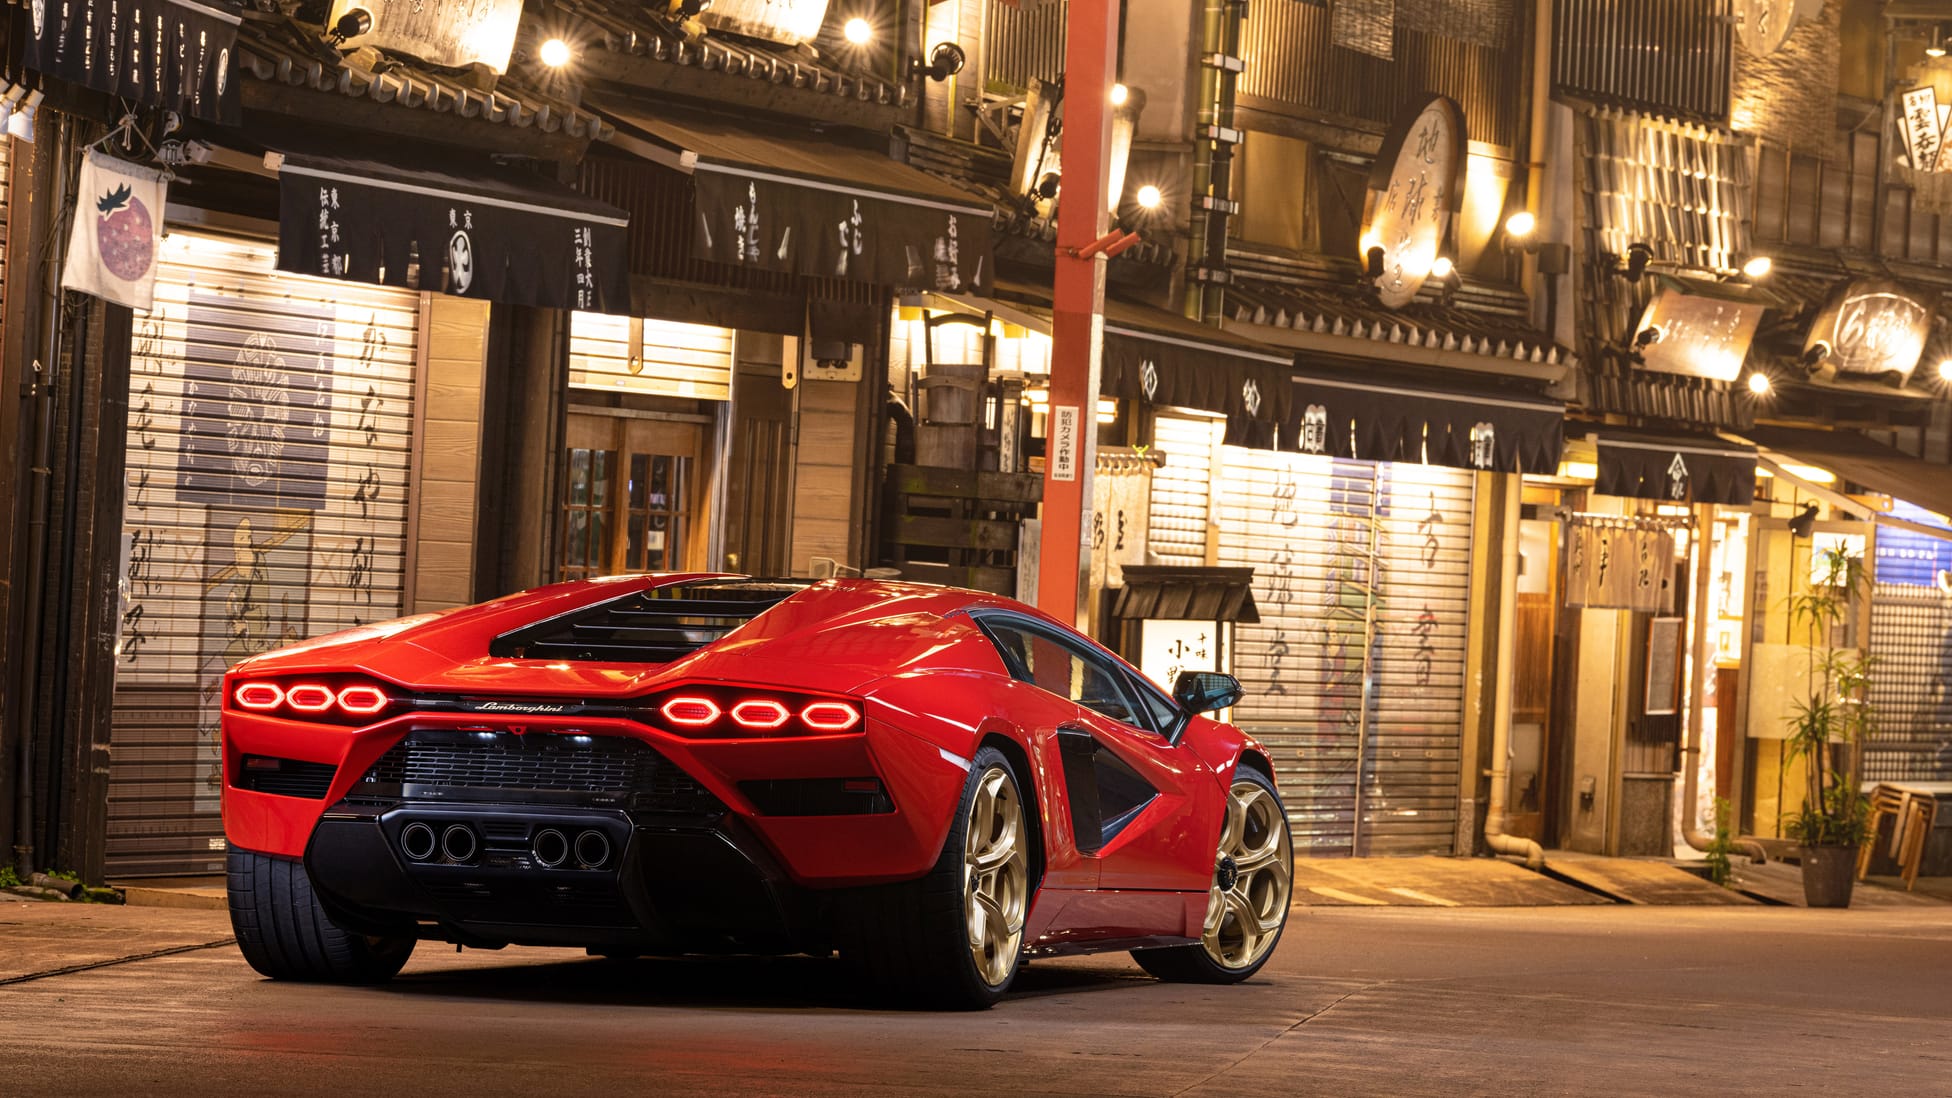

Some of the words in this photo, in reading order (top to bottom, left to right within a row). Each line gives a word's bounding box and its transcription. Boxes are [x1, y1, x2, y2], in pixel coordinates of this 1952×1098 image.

[331, 187, 342, 275] 東京都
[449, 208, 473, 230] 東京
[574, 228, 585, 309] 三年四月
[1058, 411, 1072, 470] 防犯カメラ作動中
[1195, 632, 1207, 660] 十味
[474, 701, 564, 713] Lamborghini
